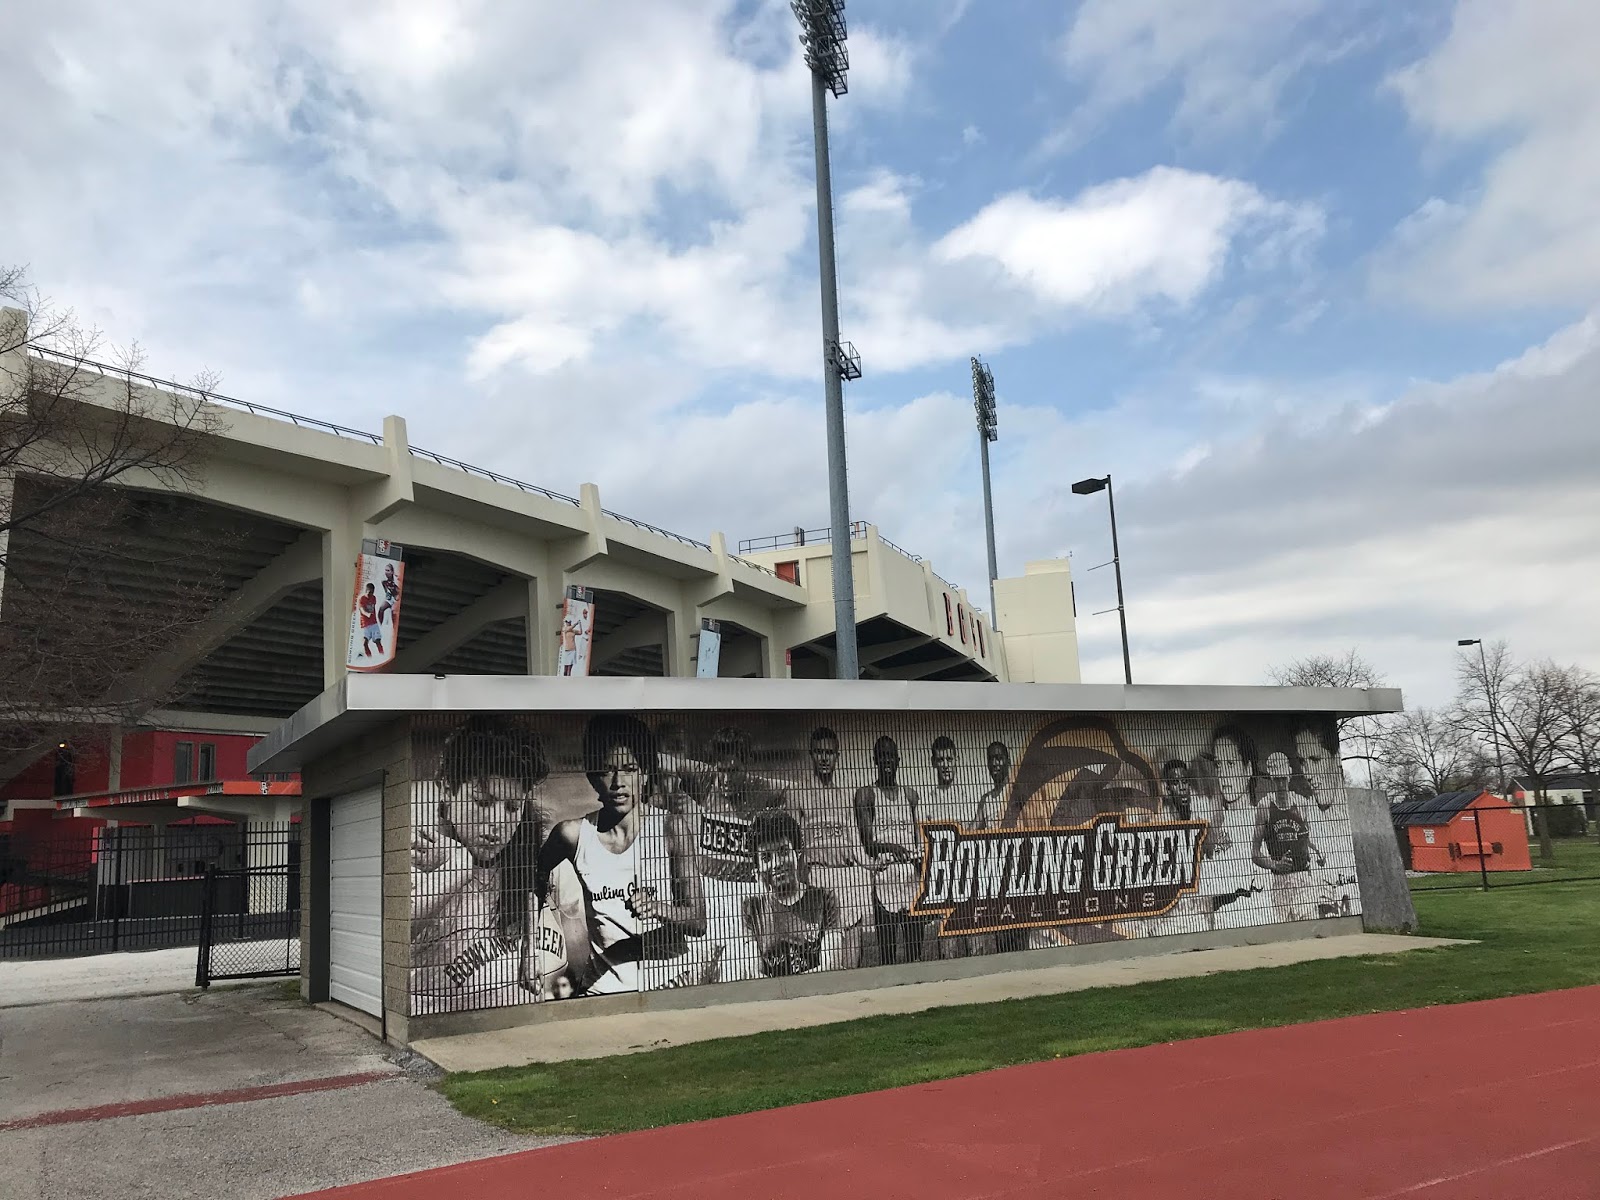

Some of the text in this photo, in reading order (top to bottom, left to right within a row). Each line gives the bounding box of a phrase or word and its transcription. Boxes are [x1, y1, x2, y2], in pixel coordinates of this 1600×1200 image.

[922, 822, 1202, 904] BOWLING GREEN
[973, 892, 1156, 922] FALCONS
[535, 925, 564, 960] REEN
